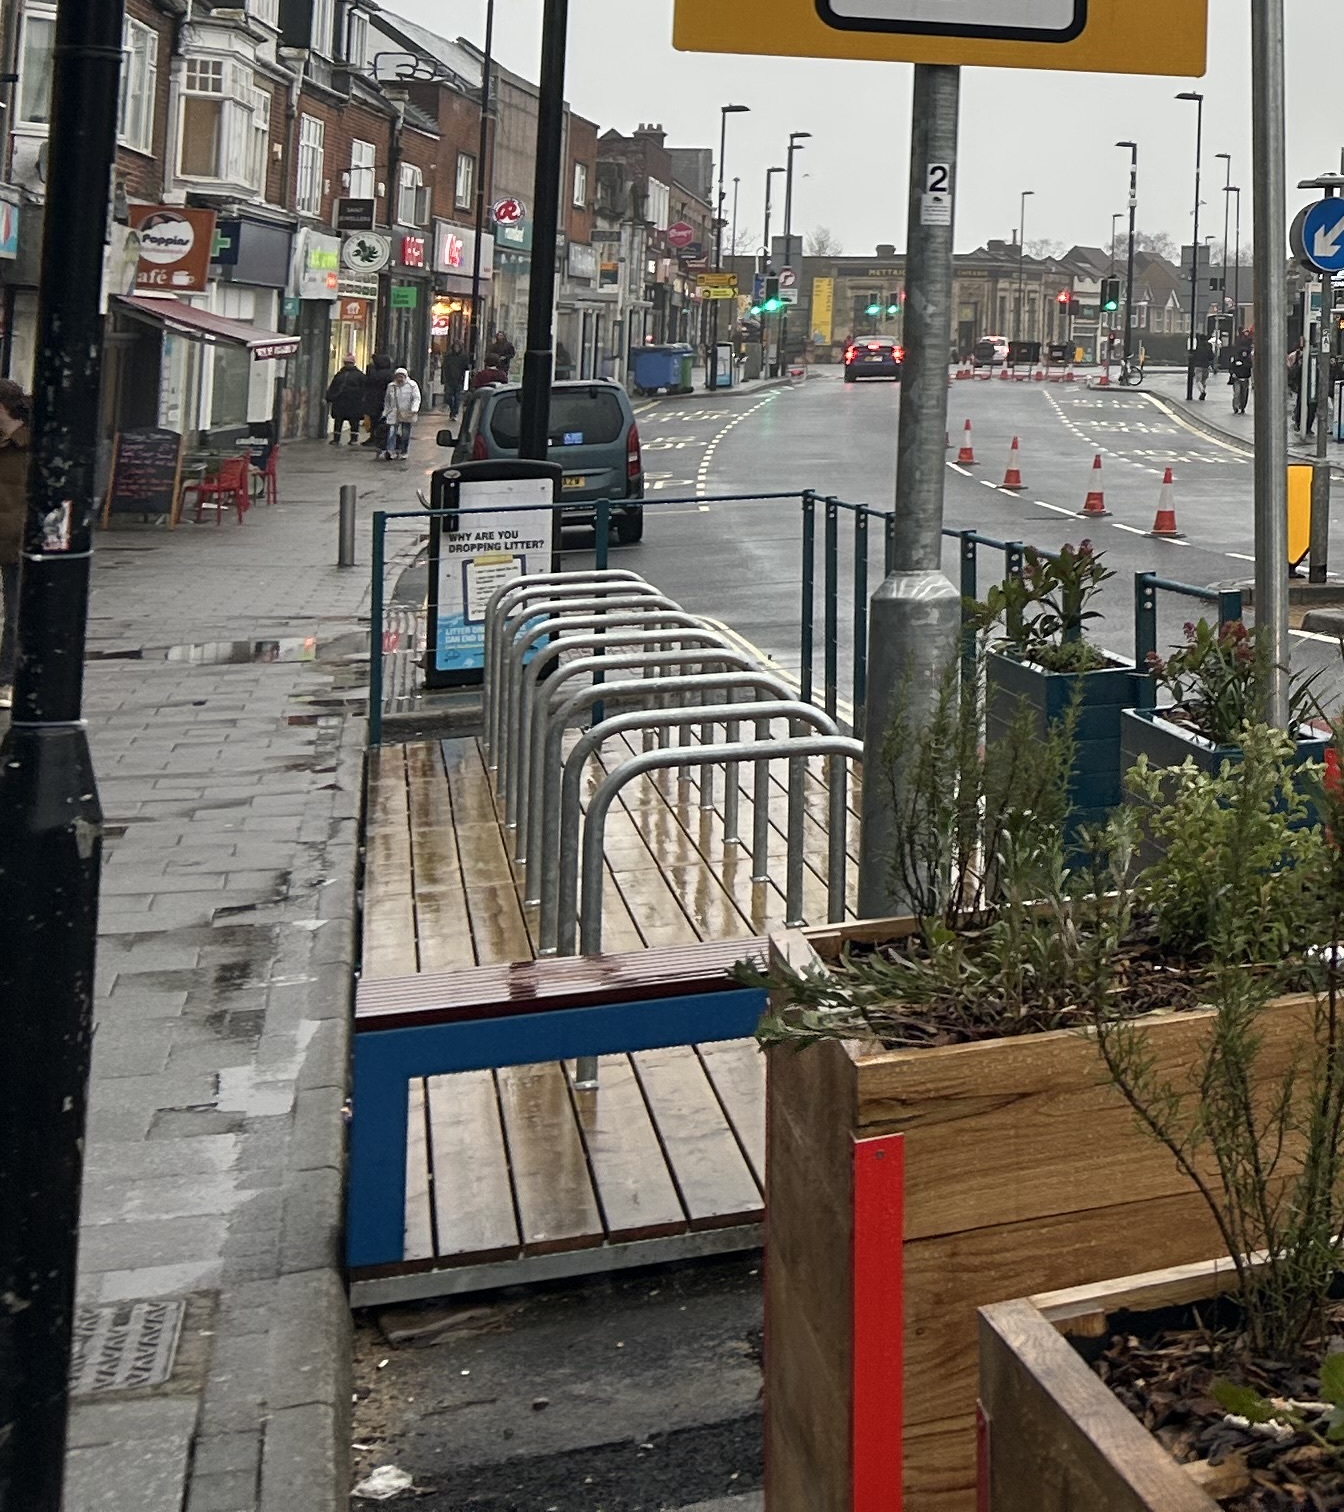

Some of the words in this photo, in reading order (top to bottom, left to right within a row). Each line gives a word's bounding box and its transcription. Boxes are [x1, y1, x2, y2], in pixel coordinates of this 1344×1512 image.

[929, 165, 948, 192] 2
[142, 234, 190, 246] Poppins
[137, 268, 169, 285] afé
[448, 532, 472, 543] WHY
[475, 531, 495, 541] ARE
[498, 530, 519, 540] YOU
[448, 542, 502, 554] DROPPING
[504, 540, 544, 550] LITTER?
